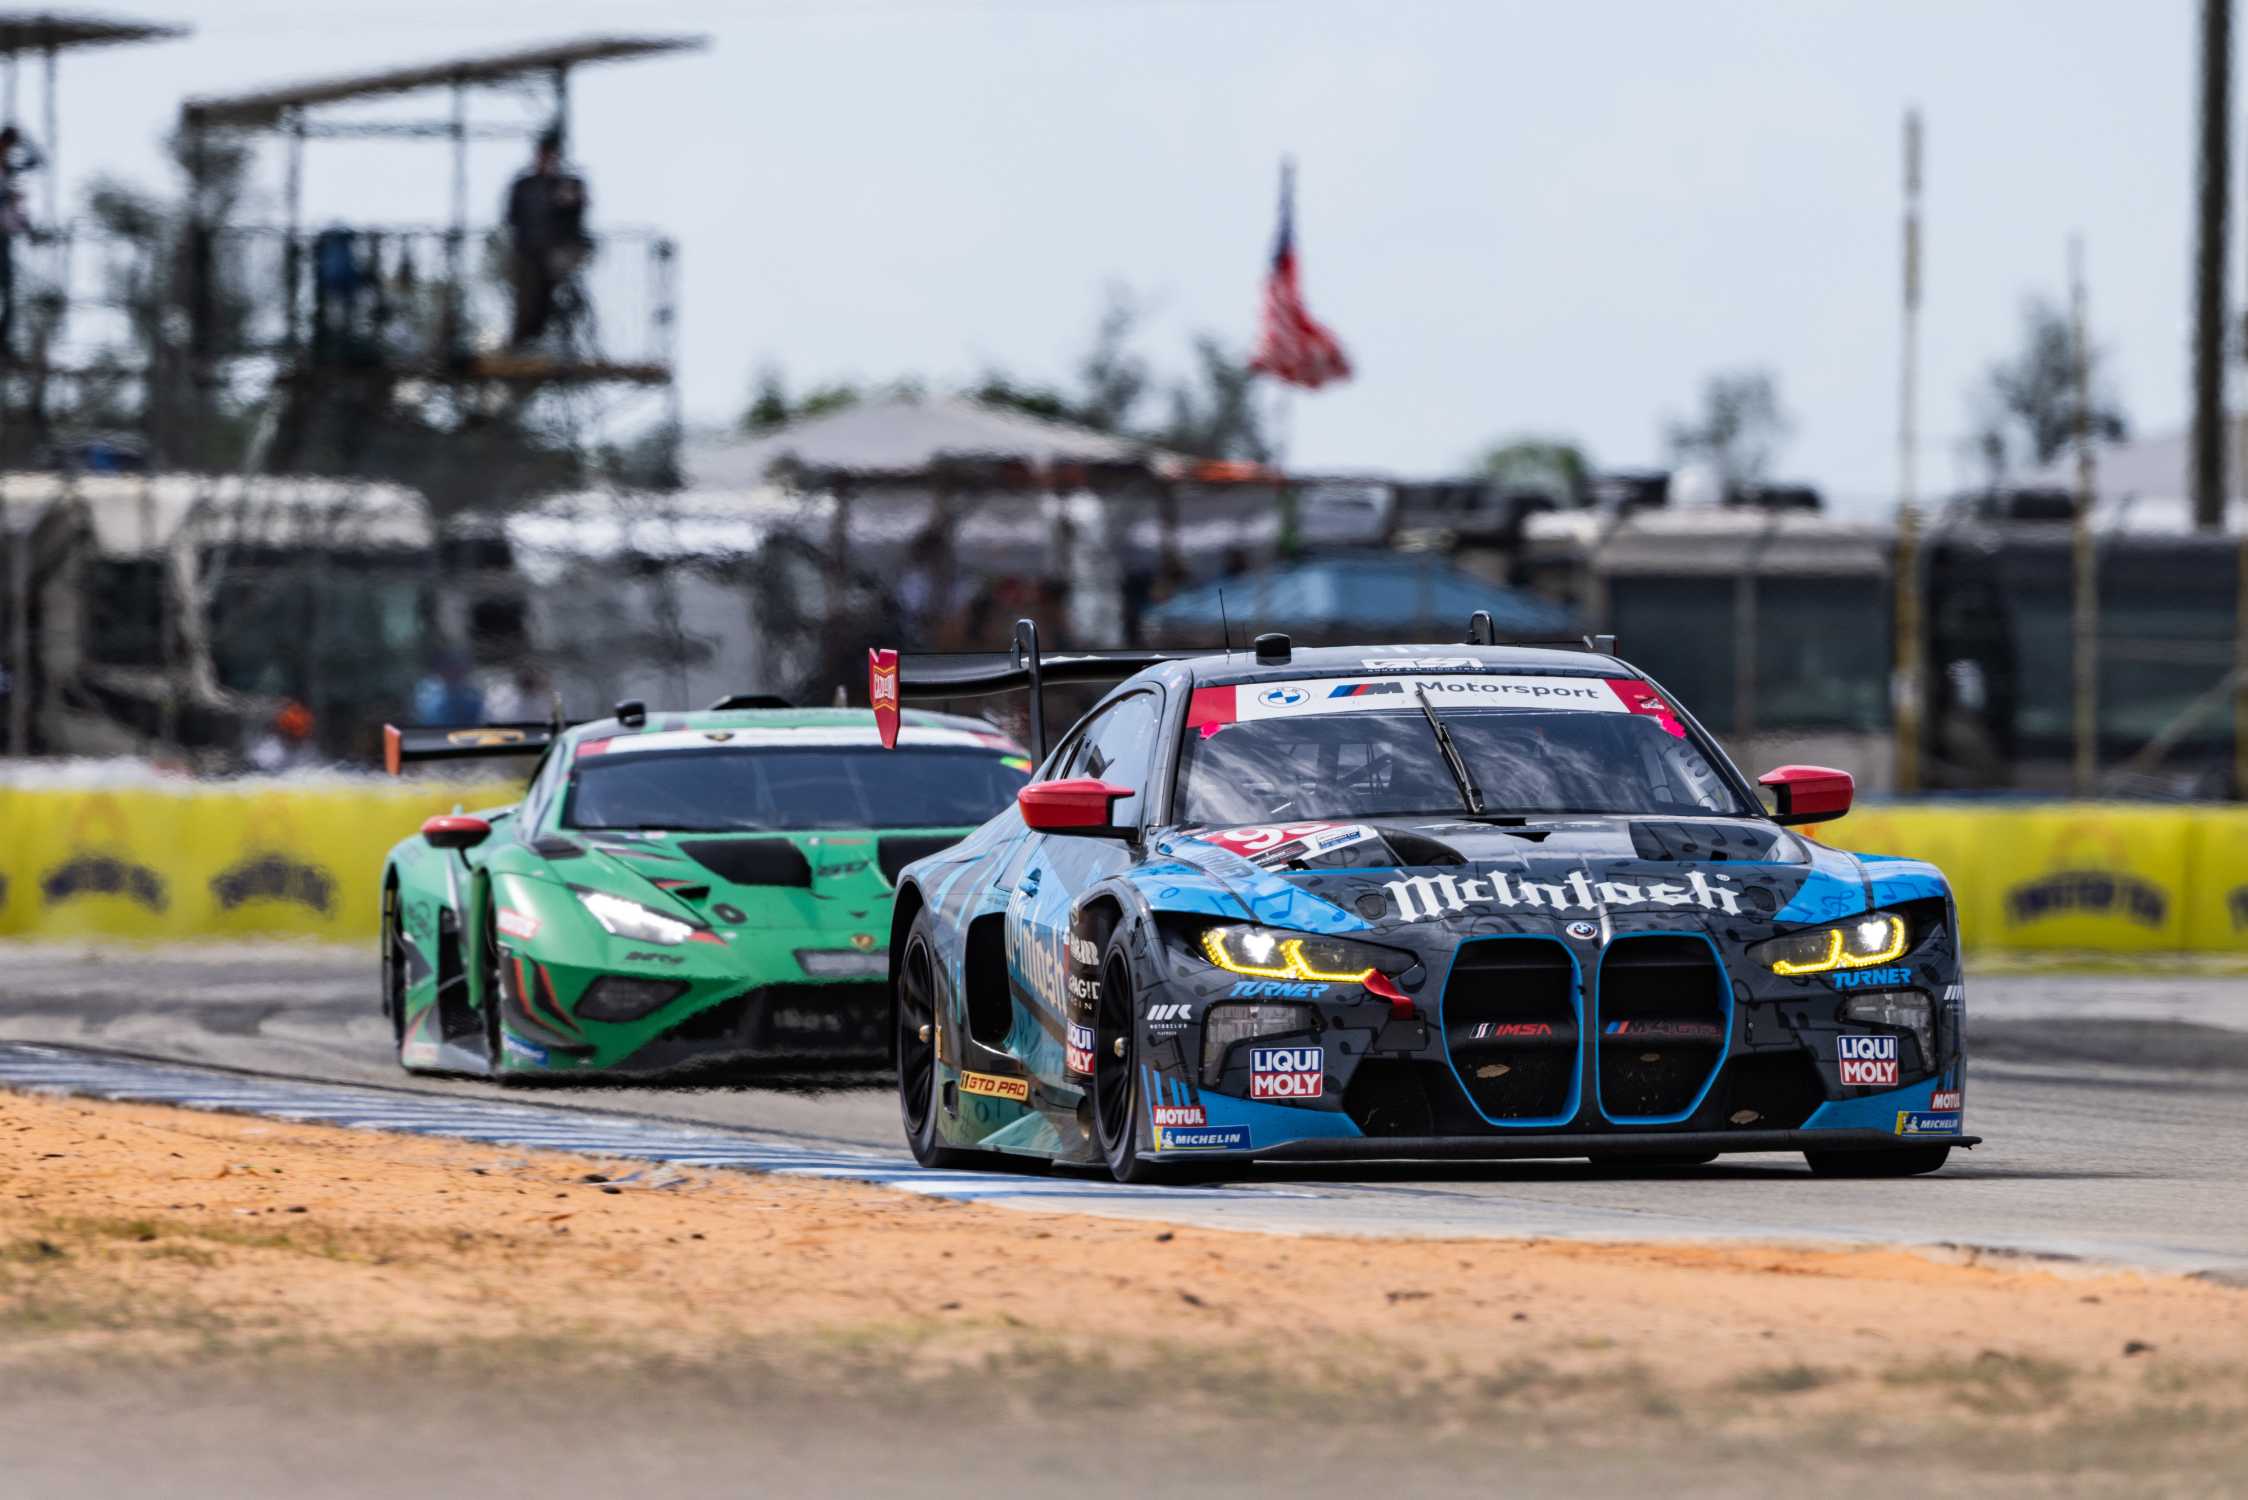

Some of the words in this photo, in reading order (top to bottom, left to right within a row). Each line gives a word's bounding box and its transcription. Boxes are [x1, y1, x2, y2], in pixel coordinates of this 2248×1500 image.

[1415, 681, 1600, 699] Motorsport
[1383, 870, 1742, 922] McIntosh
[1832, 968, 1914, 988] TURNER
[1230, 981, 1330, 998] TURNER
[1495, 1023, 1552, 1037] IMSA
[1842, 1037, 1894, 1060] LIQUI
[1253, 1050, 1319, 1073] LIQUI
[1843, 1061, 1896, 1083] MOLY
[968, 1075, 994, 1092] GTD
[997, 1078, 1026, 1096] PRO
[1253, 1072, 1321, 1096] MOLY
[1155, 1107, 1204, 1125] MOTUL
[1175, 1133, 1240, 1144] MICHELIN
